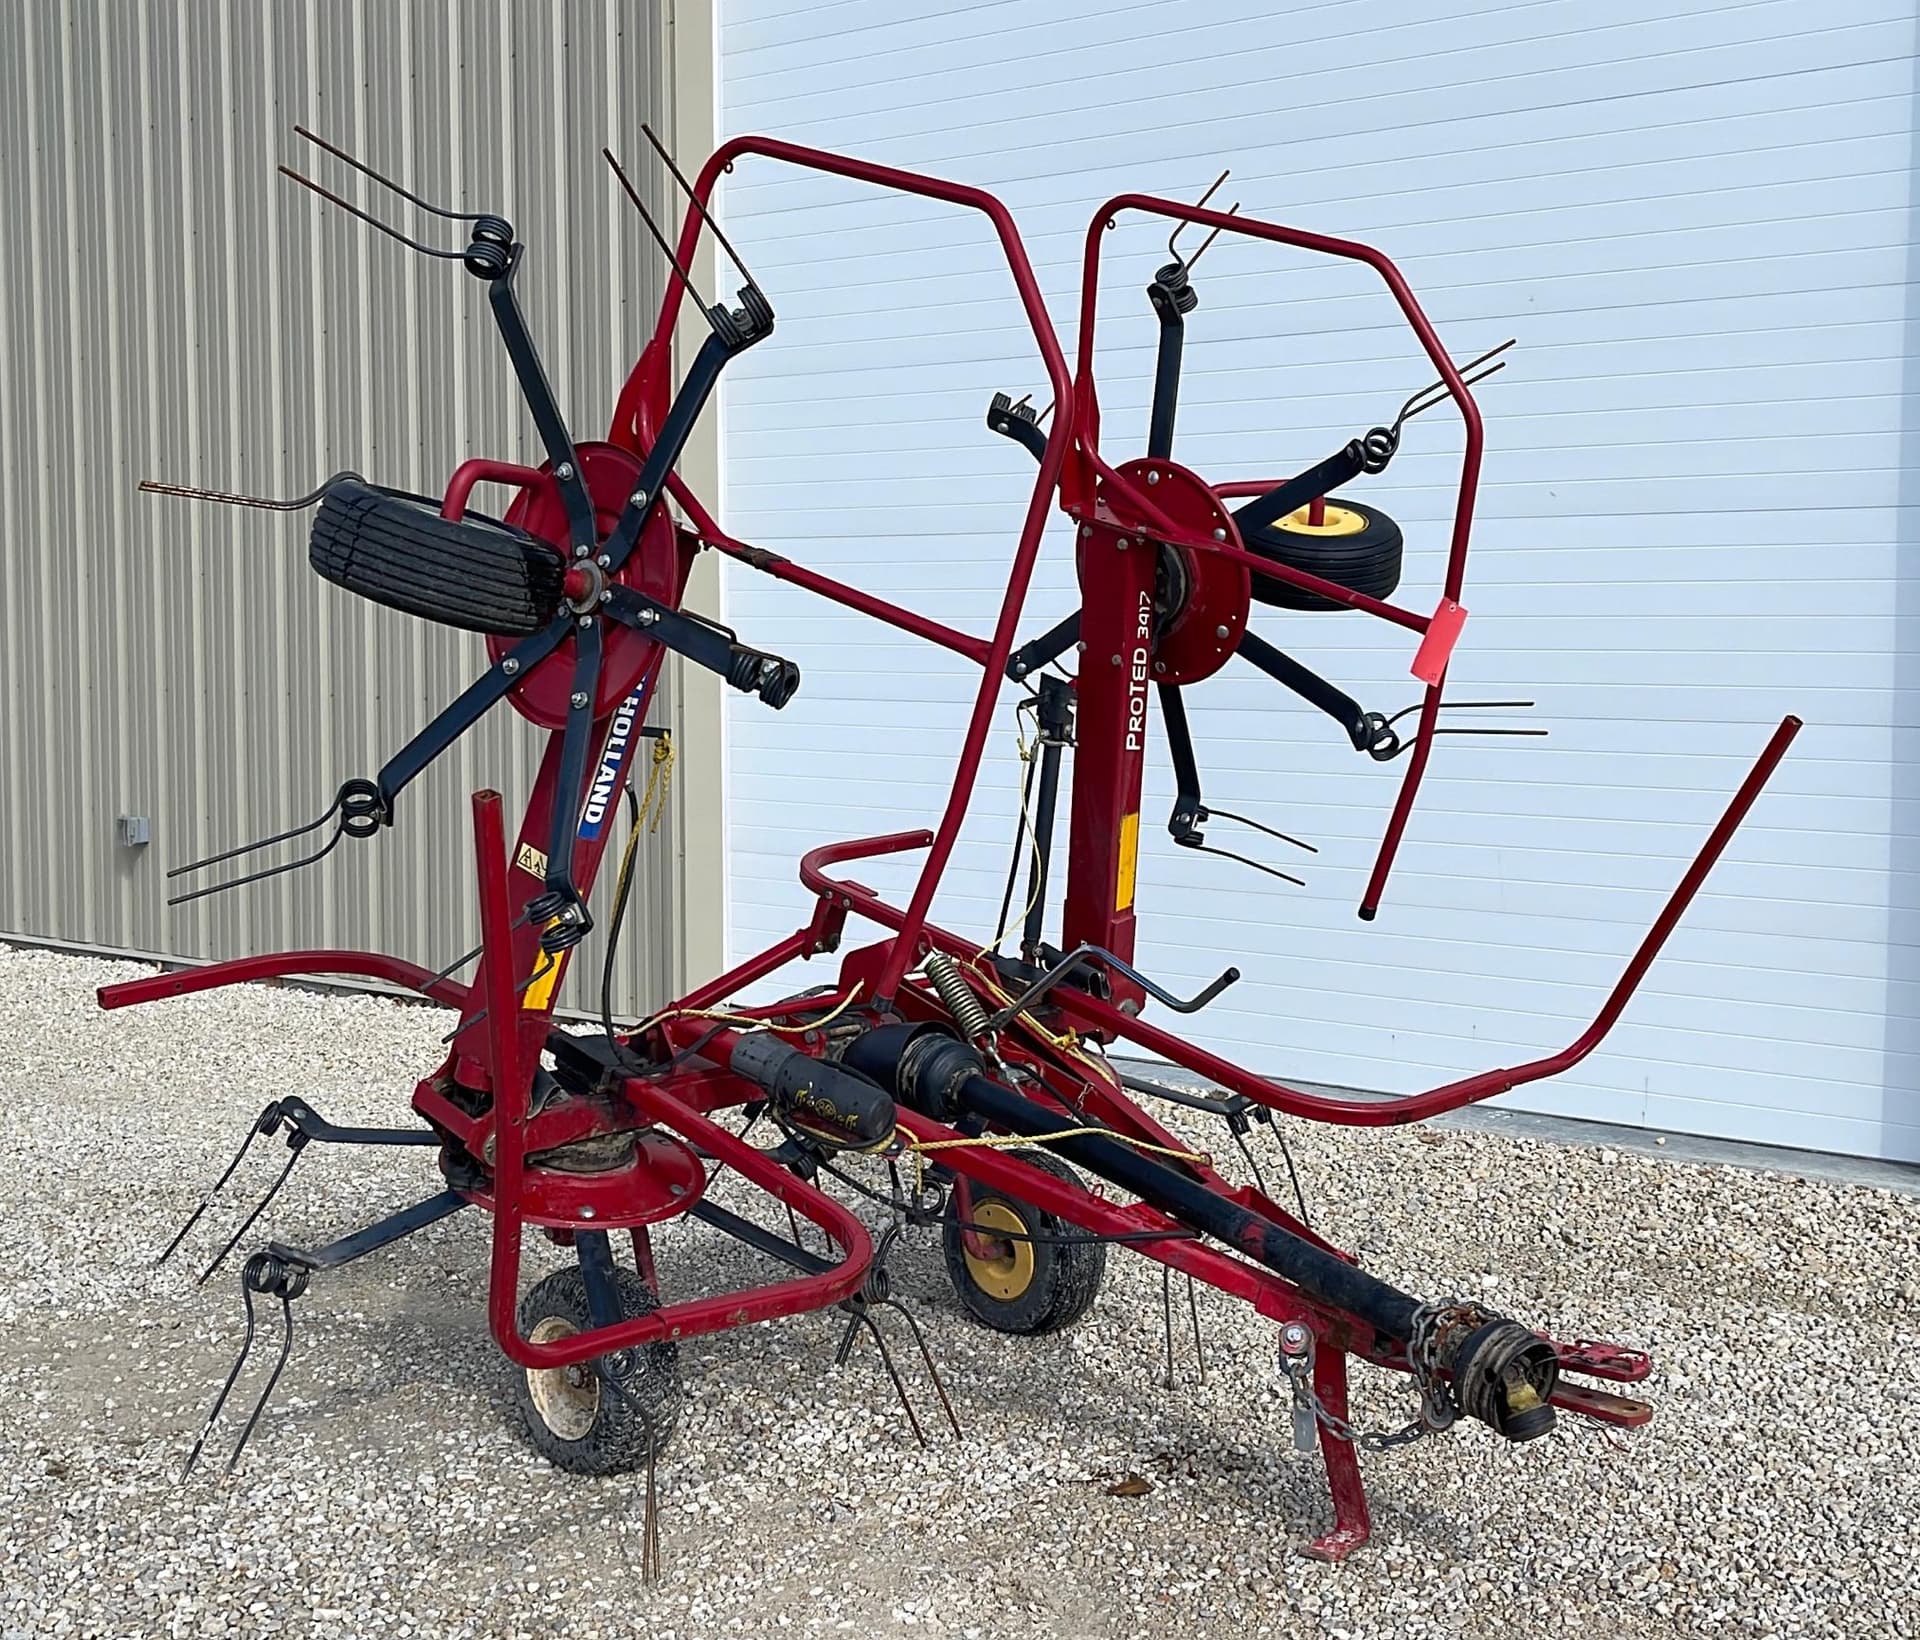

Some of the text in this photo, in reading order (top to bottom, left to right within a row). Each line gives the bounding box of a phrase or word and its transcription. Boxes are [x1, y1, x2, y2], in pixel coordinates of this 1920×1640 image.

[1126, 591, 1151, 750] PROTED 3417
[585, 696, 640, 824] HOLLAND
